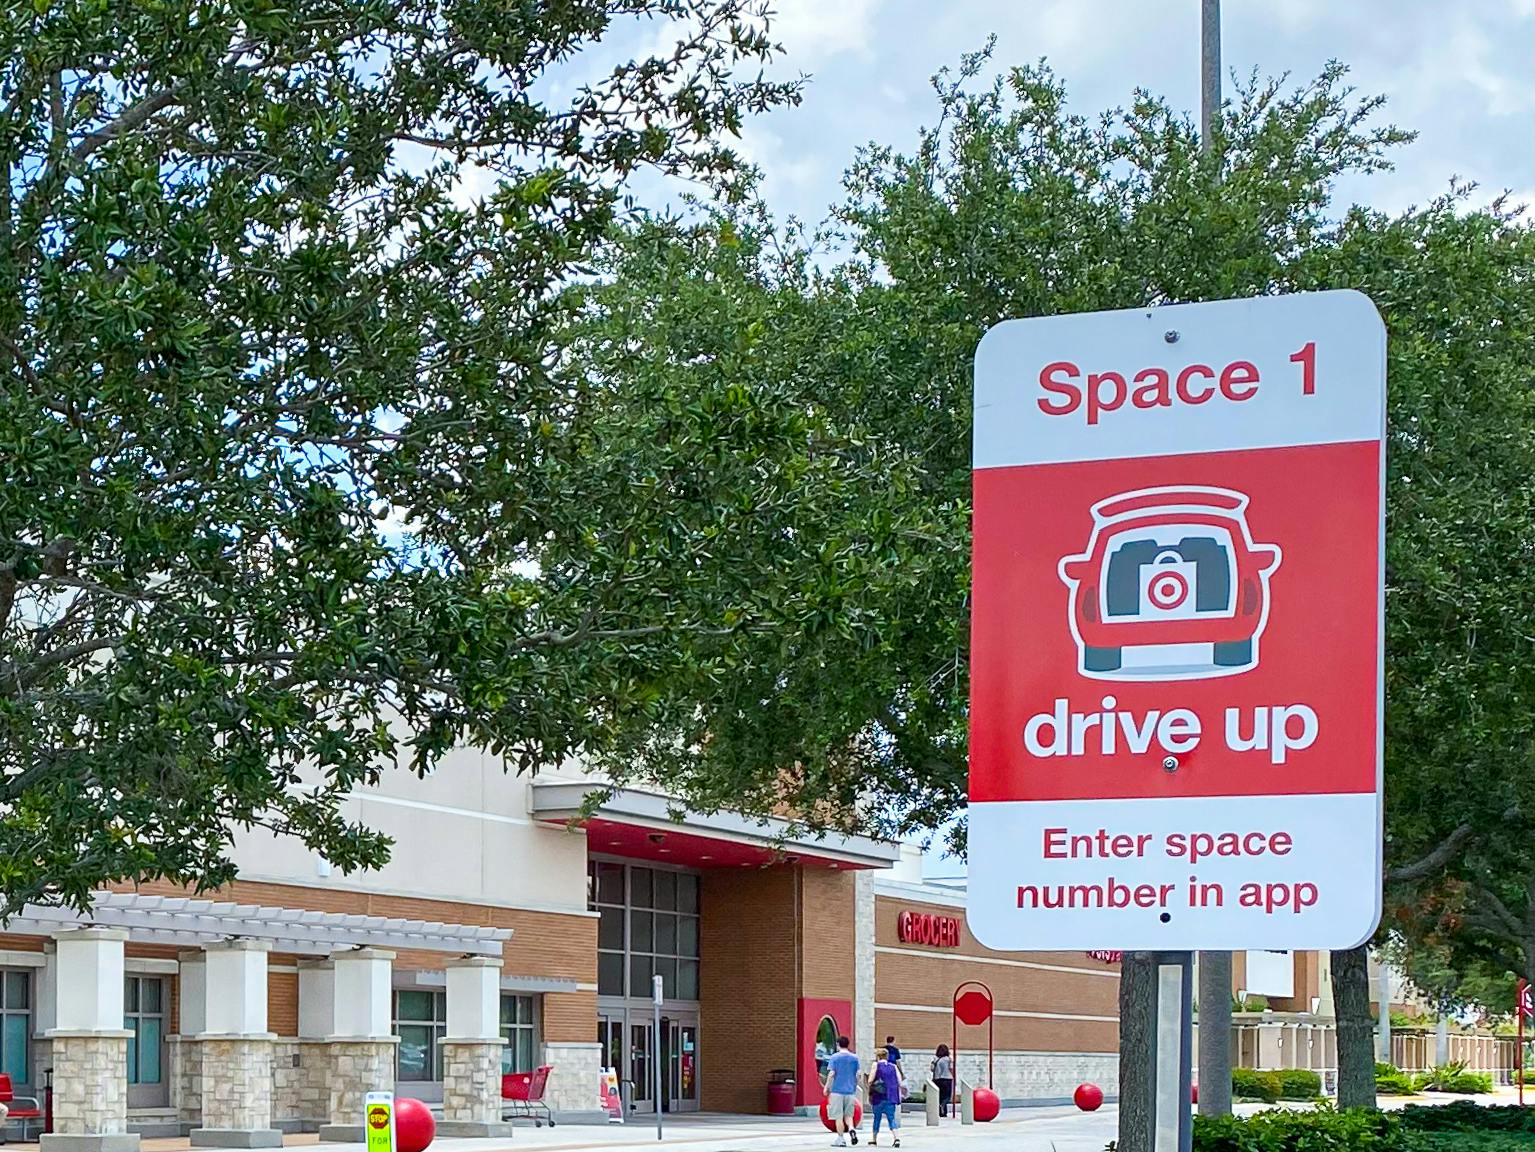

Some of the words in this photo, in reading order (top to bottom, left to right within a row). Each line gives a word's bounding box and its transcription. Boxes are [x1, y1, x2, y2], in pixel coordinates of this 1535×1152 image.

[1037, 360, 1260, 425] Space
[1289, 341, 1318, 396] 1
[1023, 696, 1202, 758] drive
[1225, 704, 1319, 764] up
[1042, 827, 1152, 860] Enter
[1166, 829, 1293, 863] space
[1016, 877, 1175, 910] number
[1189, 876, 1224, 908] in
[1238, 883, 1320, 914] app
[899, 911, 961, 947] GROCERY
[370, 1113, 388, 1123] STOP
[372, 1136, 388, 1145] FOR
